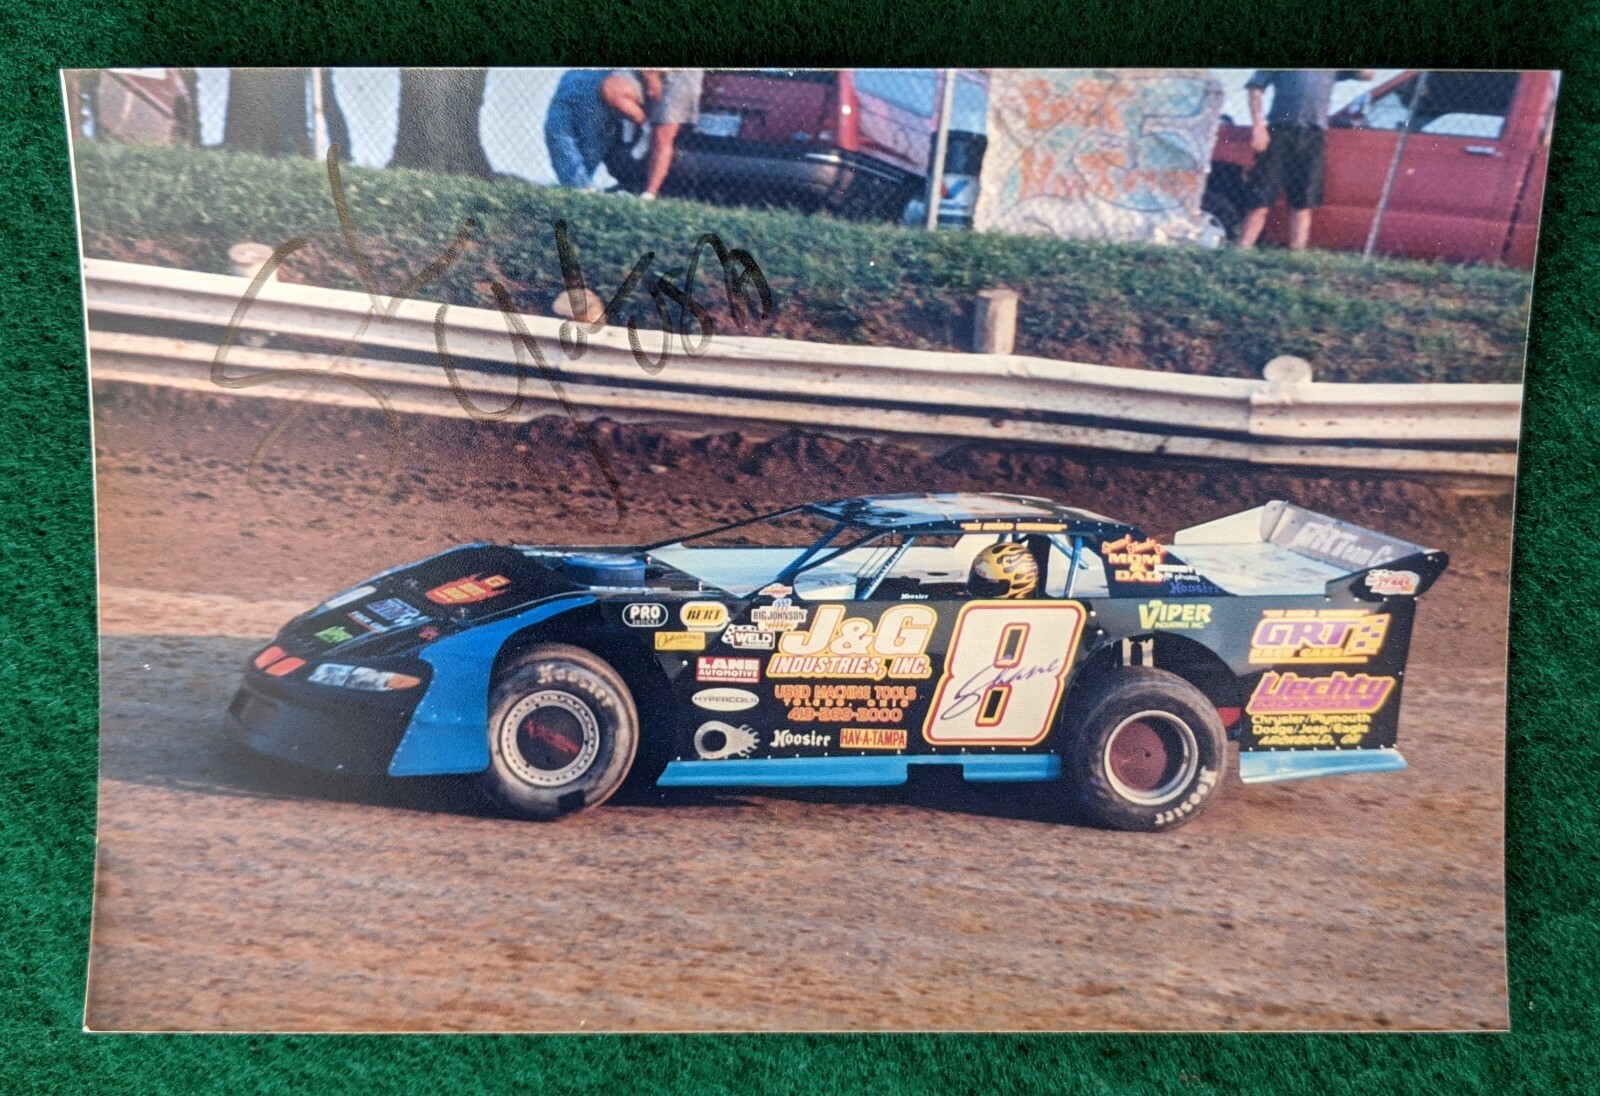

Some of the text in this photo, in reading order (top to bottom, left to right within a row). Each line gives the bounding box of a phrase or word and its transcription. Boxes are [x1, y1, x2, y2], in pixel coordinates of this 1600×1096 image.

[1108, 553, 1162, 565] MOM
[1114, 569, 1165, 582] DAD
[630, 605, 661, 619] PRO
[753, 610, 805, 621] BIG JOHNSON
[1138, 600, 1214, 630] VIPER
[780, 604, 938, 656] J&G
[1253, 619, 1360, 648] GRT
[735, 632, 773, 645] WELD
[697, 668, 759, 679] AUTOMOTIVE
[767, 654, 931, 680] INDUSTRIES, INC.
[922, 600, 1087, 746] 8
[774, 684, 917, 701] USED MACHINE TOOLS
[786, 706, 904, 722] 419-269-2000
[769, 729, 832, 748] Hoosier
